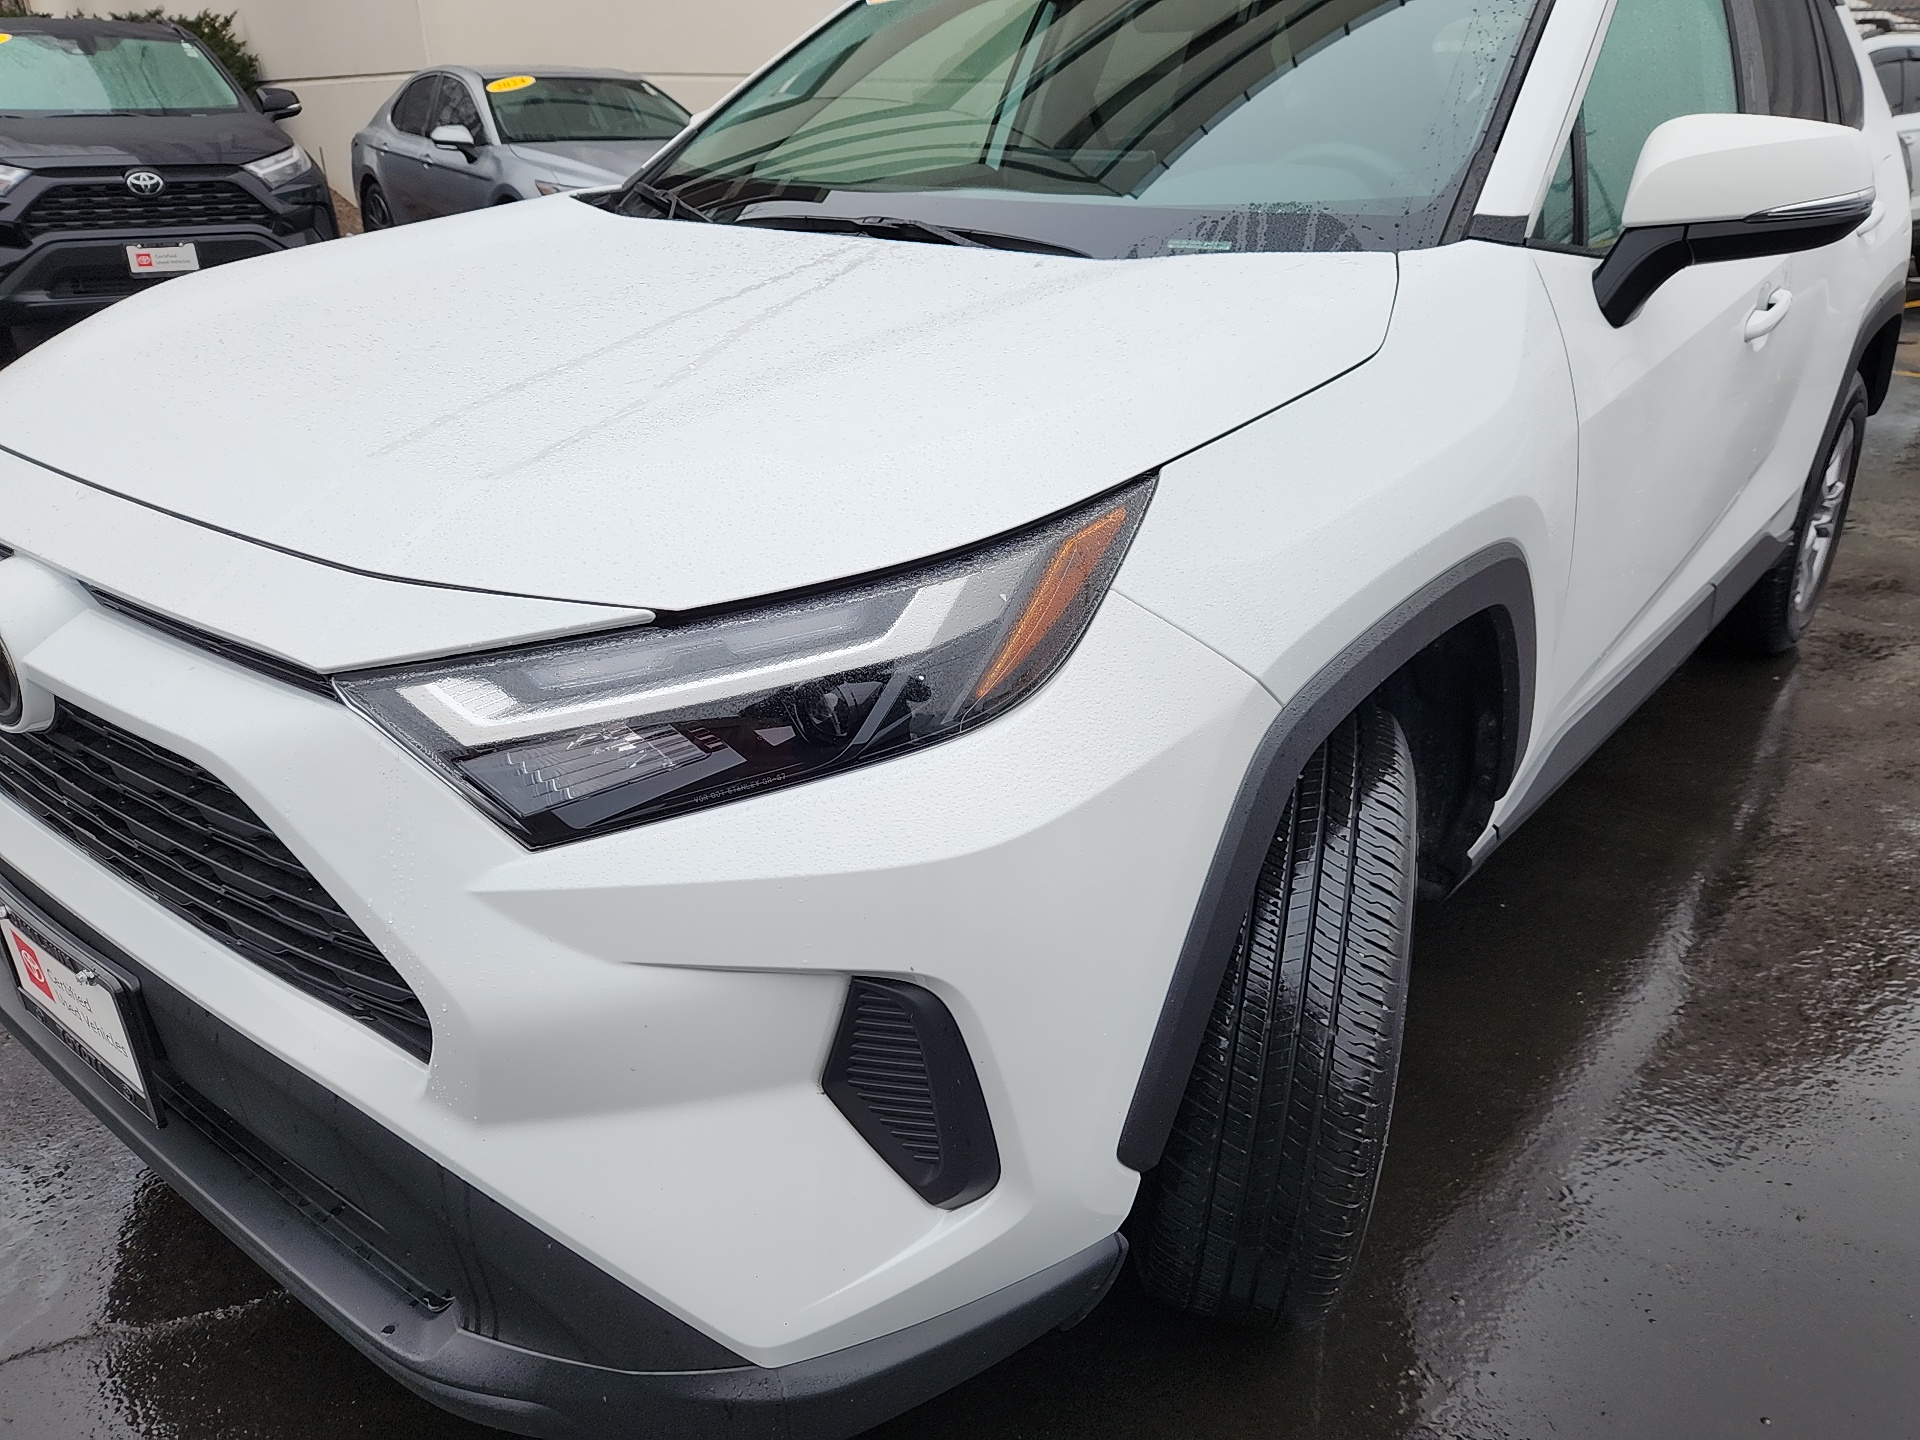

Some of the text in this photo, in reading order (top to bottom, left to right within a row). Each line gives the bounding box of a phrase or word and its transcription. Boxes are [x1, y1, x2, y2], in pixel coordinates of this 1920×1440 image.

[727, 780, 760, 794] STANLEY
[46, 968, 93, 1013] Certified
[55, 989, 129, 1057] Used Vehicles
